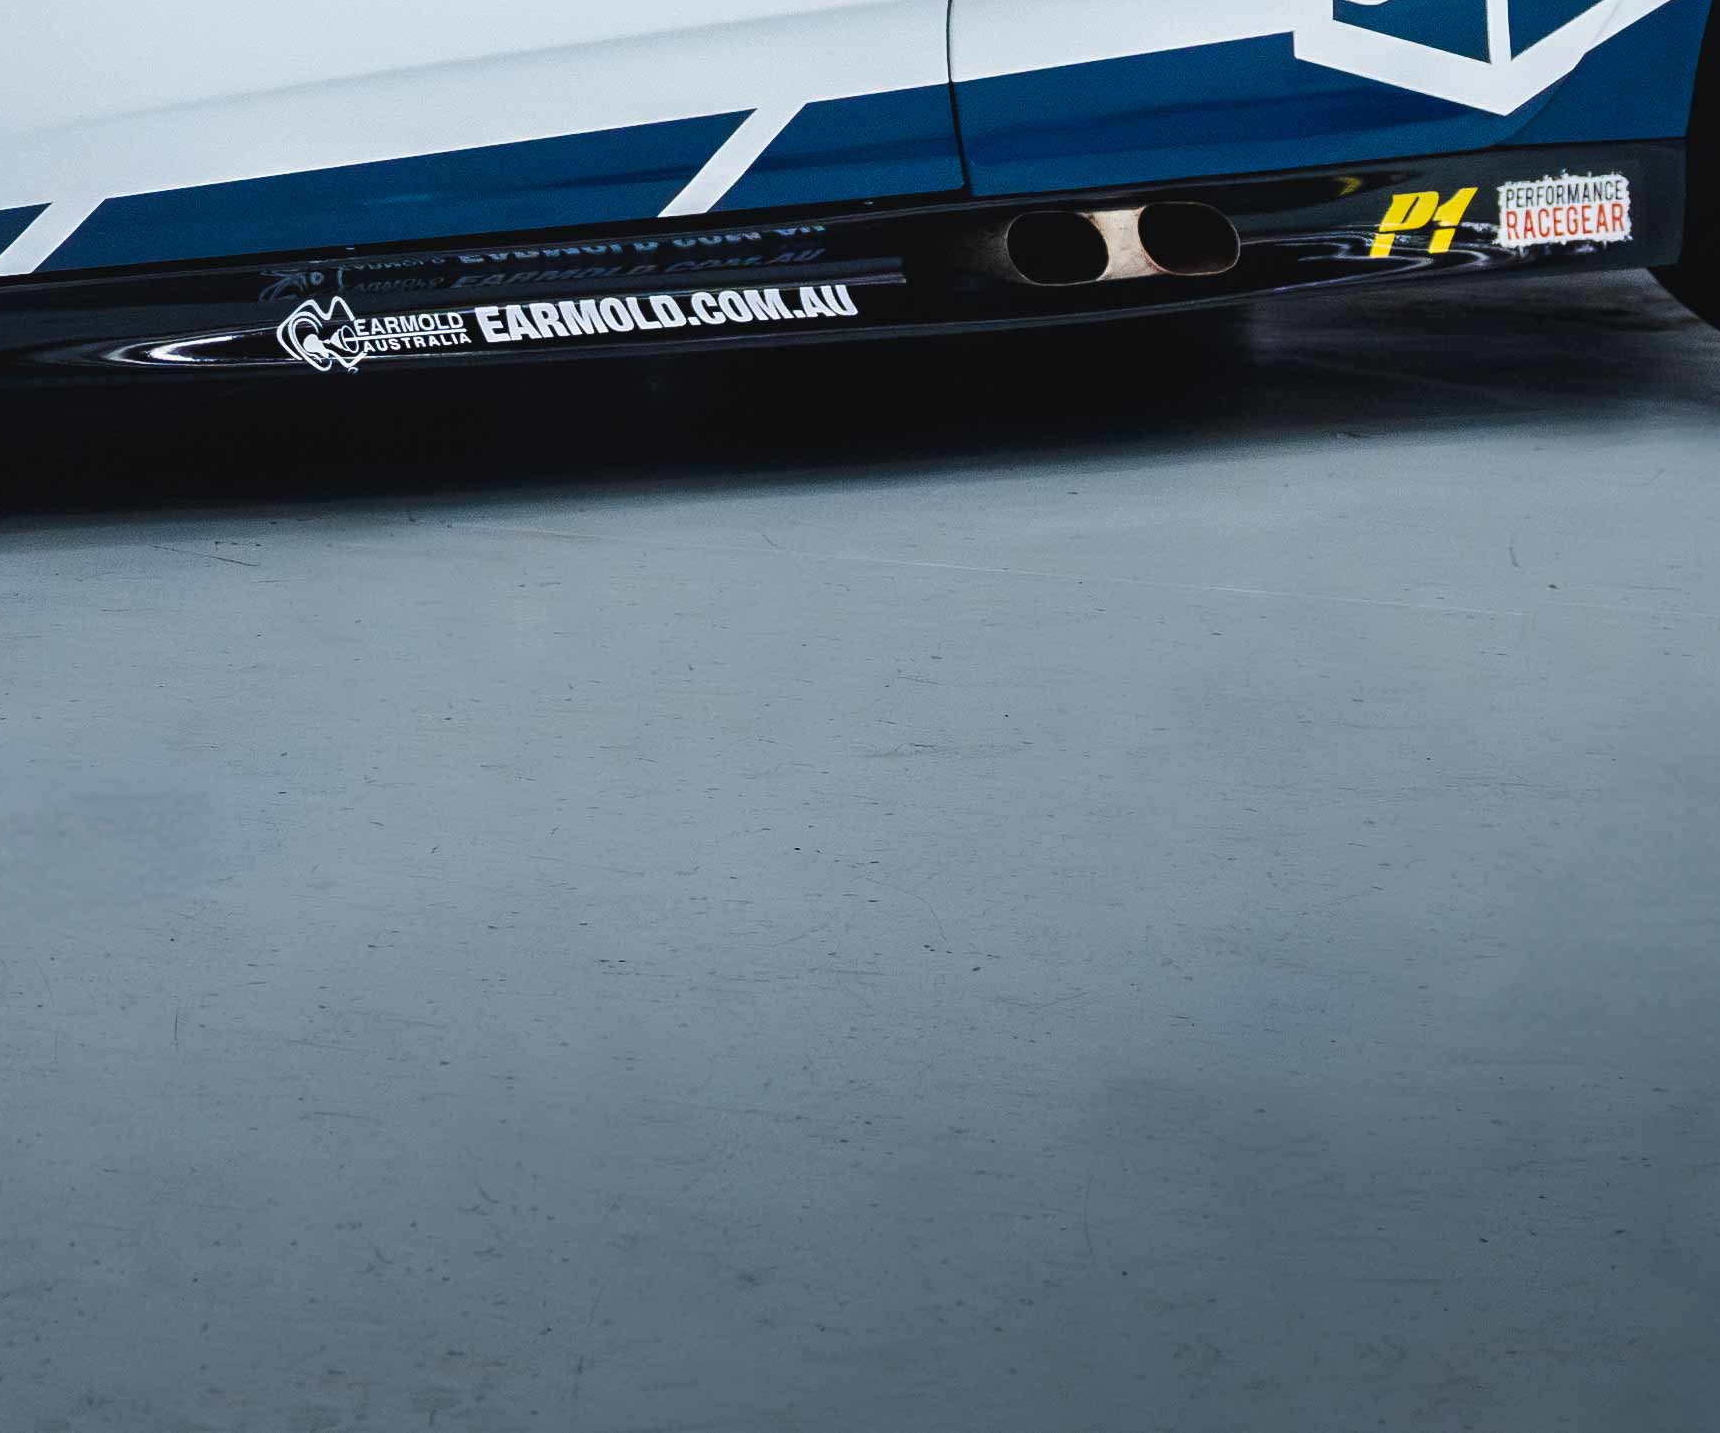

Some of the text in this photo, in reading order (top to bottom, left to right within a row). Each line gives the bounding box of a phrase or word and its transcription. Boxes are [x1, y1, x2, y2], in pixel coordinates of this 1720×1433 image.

[1505, 179, 1624, 208] PERFORMANCE
[1369, 186, 1479, 259] P1
[1505, 202, 1626, 240] RACEGEAR
[354, 312, 464, 336] EARMOLD
[476, 284, 859, 345] EARMOLD.COM.AU
[363, 333, 472, 354] AUSTRALIA
